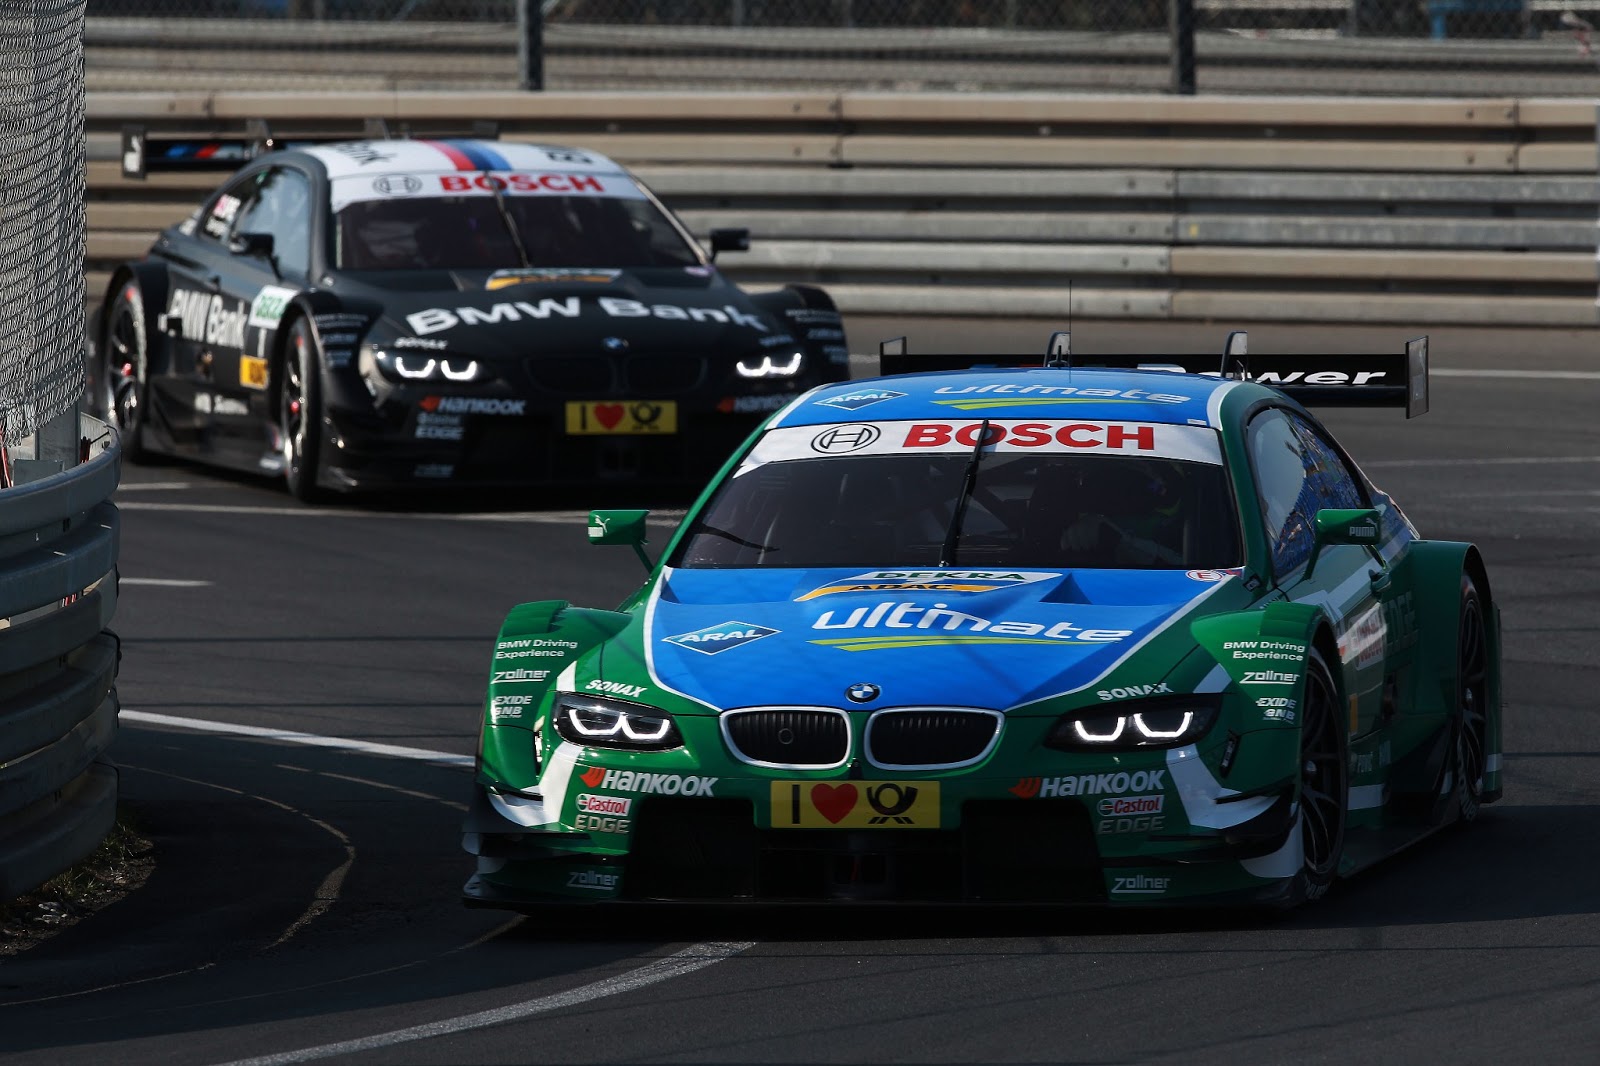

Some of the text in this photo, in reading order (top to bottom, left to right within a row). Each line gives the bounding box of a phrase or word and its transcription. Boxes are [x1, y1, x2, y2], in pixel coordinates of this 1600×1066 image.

[439, 174, 604, 192] BOSCH
[406, 297, 581, 335] BMW
[598, 297, 768, 332] Bank
[827, 391, 894, 403] ARAL
[934, 384, 1191, 404] ultimate
[902, 423, 1154, 451] BOSCH
[1349, 526, 1376, 537] PUMA
[873, 572, 1026, 581] DEKRA
[848, 583, 954, 591] ADAC
[812, 601, 1134, 641] ultimate
[497, 639, 578, 649] BMW Driving
[677, 627, 762, 644] ARAL
[495, 649, 565, 660] Experience
[1223, 641, 1305, 653] BMW Driving
[1232, 650, 1304, 661] Experience
[585, 680, 648, 698] SONAX
[1096, 682, 1175, 701] SONAX
[494, 696, 533, 705] EXIDE
[1256, 697, 1297, 709] EXIDE
[587, 795, 627, 814] Castrol
[791, 784, 801, 824] I
[1113, 797, 1161, 814] Castrol
[574, 815, 632, 834] EDGE
[1096, 816, 1166, 834] EDGE
